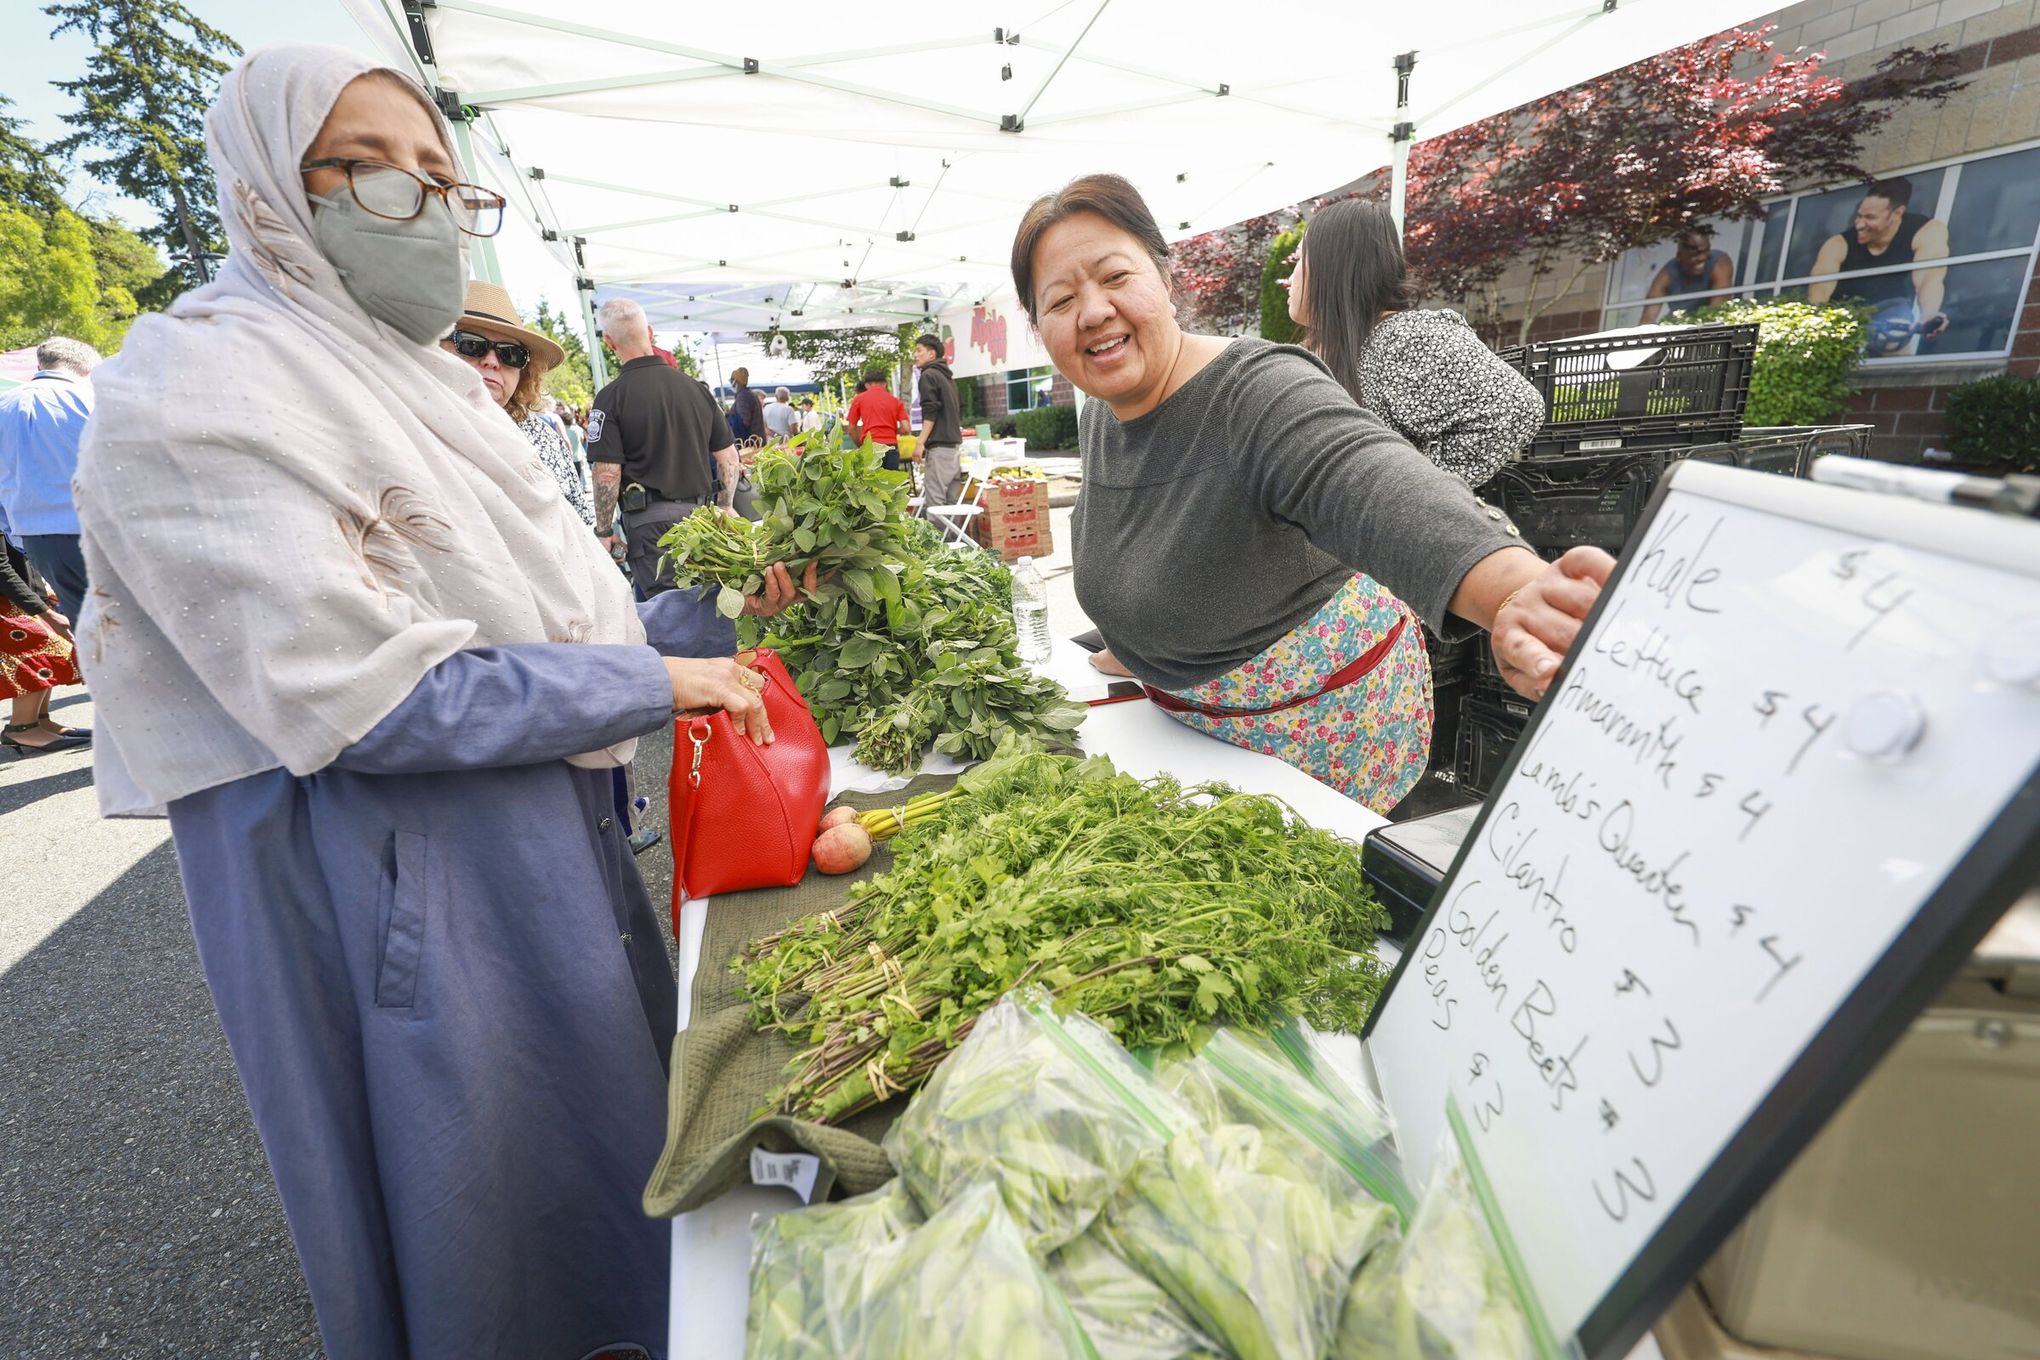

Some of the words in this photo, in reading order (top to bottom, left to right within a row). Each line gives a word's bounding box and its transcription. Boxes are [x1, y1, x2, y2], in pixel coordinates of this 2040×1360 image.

[1629, 509, 1725, 613] Kale
[1594, 598, 1703, 715] Lettuce
[1519, 719, 1601, 820] Lamb's
[1558, 666, 1686, 790] Amaranth
[1488, 801, 1577, 954] Cilantro
[1418, 926, 1459, 1032] Peas
[1447, 879, 1509, 1014] Golden
